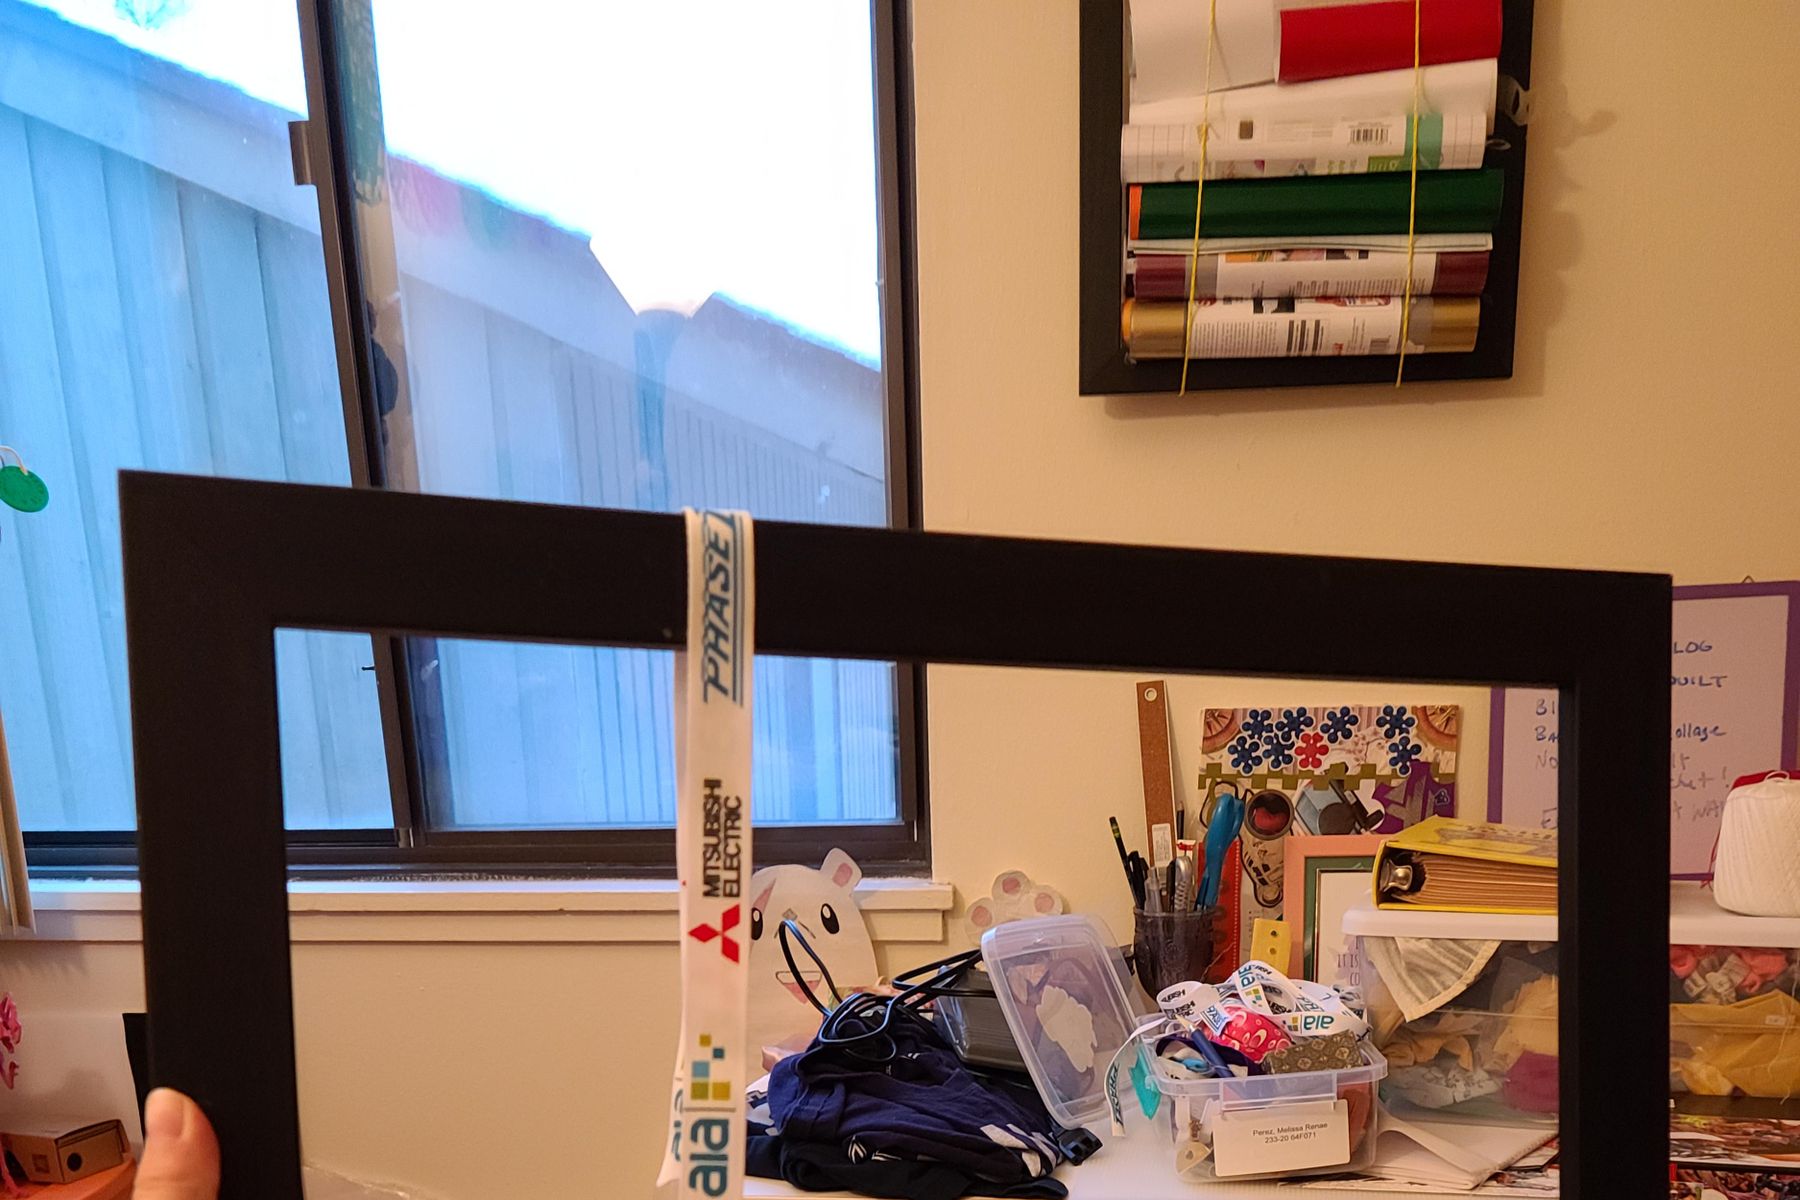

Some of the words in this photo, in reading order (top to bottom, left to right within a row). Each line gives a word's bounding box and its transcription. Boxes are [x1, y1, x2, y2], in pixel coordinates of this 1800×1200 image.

[1674, 724, 1727, 742] ollage
[703, 778, 722, 898] MITSUBISHI
[723, 795, 742, 898] ELECTRIC
[1253, 1128, 1275, 1137] Perez,
[1277, 1125, 1304, 1135] Melissa
[1305, 1122, 1328, 1130] Renae
